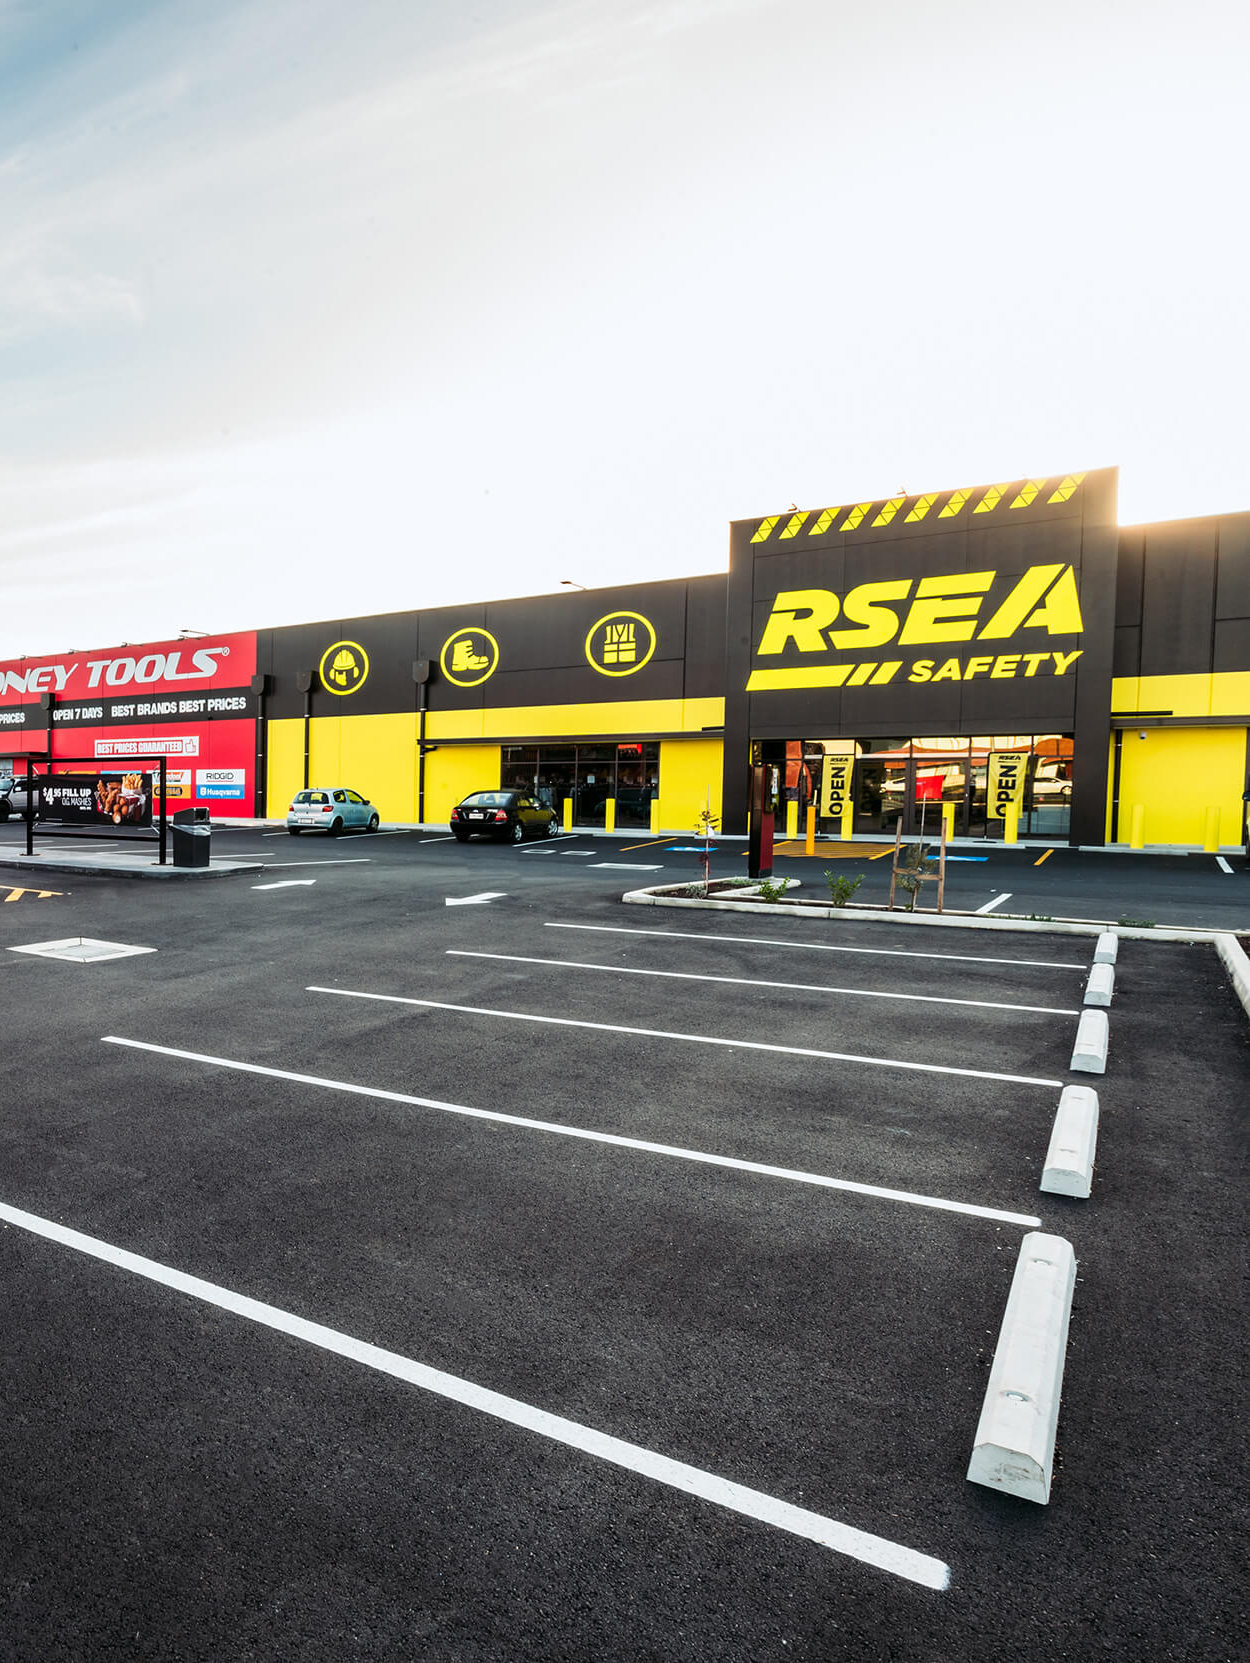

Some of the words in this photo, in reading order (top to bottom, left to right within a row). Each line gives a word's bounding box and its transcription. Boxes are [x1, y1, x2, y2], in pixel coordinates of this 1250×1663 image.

[757, 563, 1084, 655] RSEA
[907, 651, 1084, 683] SAFETY
[53, 709, 74, 721] OPEN
[75, 708, 81, 720] 7
[82, 707, 103, 720] DAYS
[111, 704, 135, 718] BEST
[137, 702, 178, 716] BRANDS
[179, 700, 206, 713] BEST
[207, 697, 247, 711] PRICES
[96, 743, 113, 754] BEST
[113, 742, 137, 753] PRICES
[138, 740, 183, 753] GUARANTEED
[206, 772, 234, 780] RIDGID
[62, 788, 79, 797] FILL
[79, 788, 91, 797] UP
[206, 788, 241, 798] Husqvarna
[829, 766, 845, 815] OPEN
[996, 765, 1017, 817] OPEN
